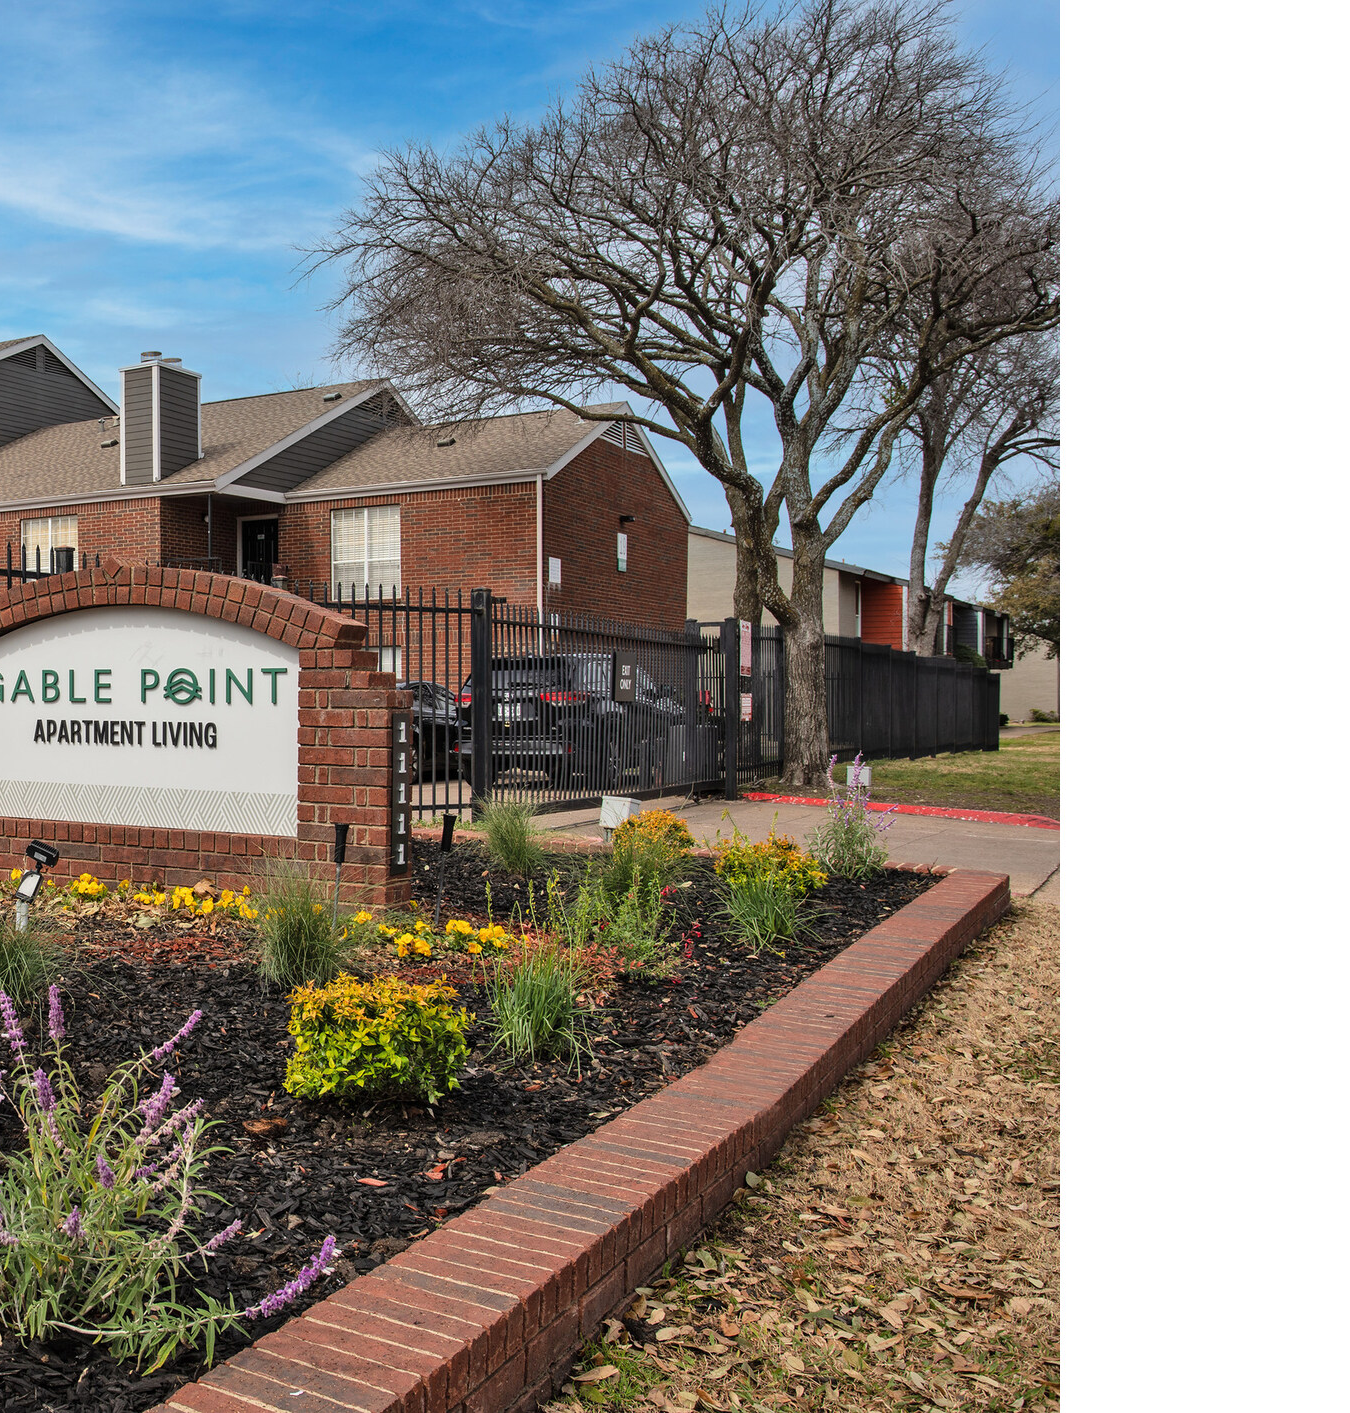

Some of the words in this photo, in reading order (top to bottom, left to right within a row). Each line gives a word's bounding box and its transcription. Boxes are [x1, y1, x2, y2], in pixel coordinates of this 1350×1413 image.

[622, 664, 631, 676] EXIT
[141, 667, 287, 705] POINT
[620, 679, 631, 690] ONLY
[33, 719, 146, 746] APARTMENT
[152, 721, 217, 748] LIVING
